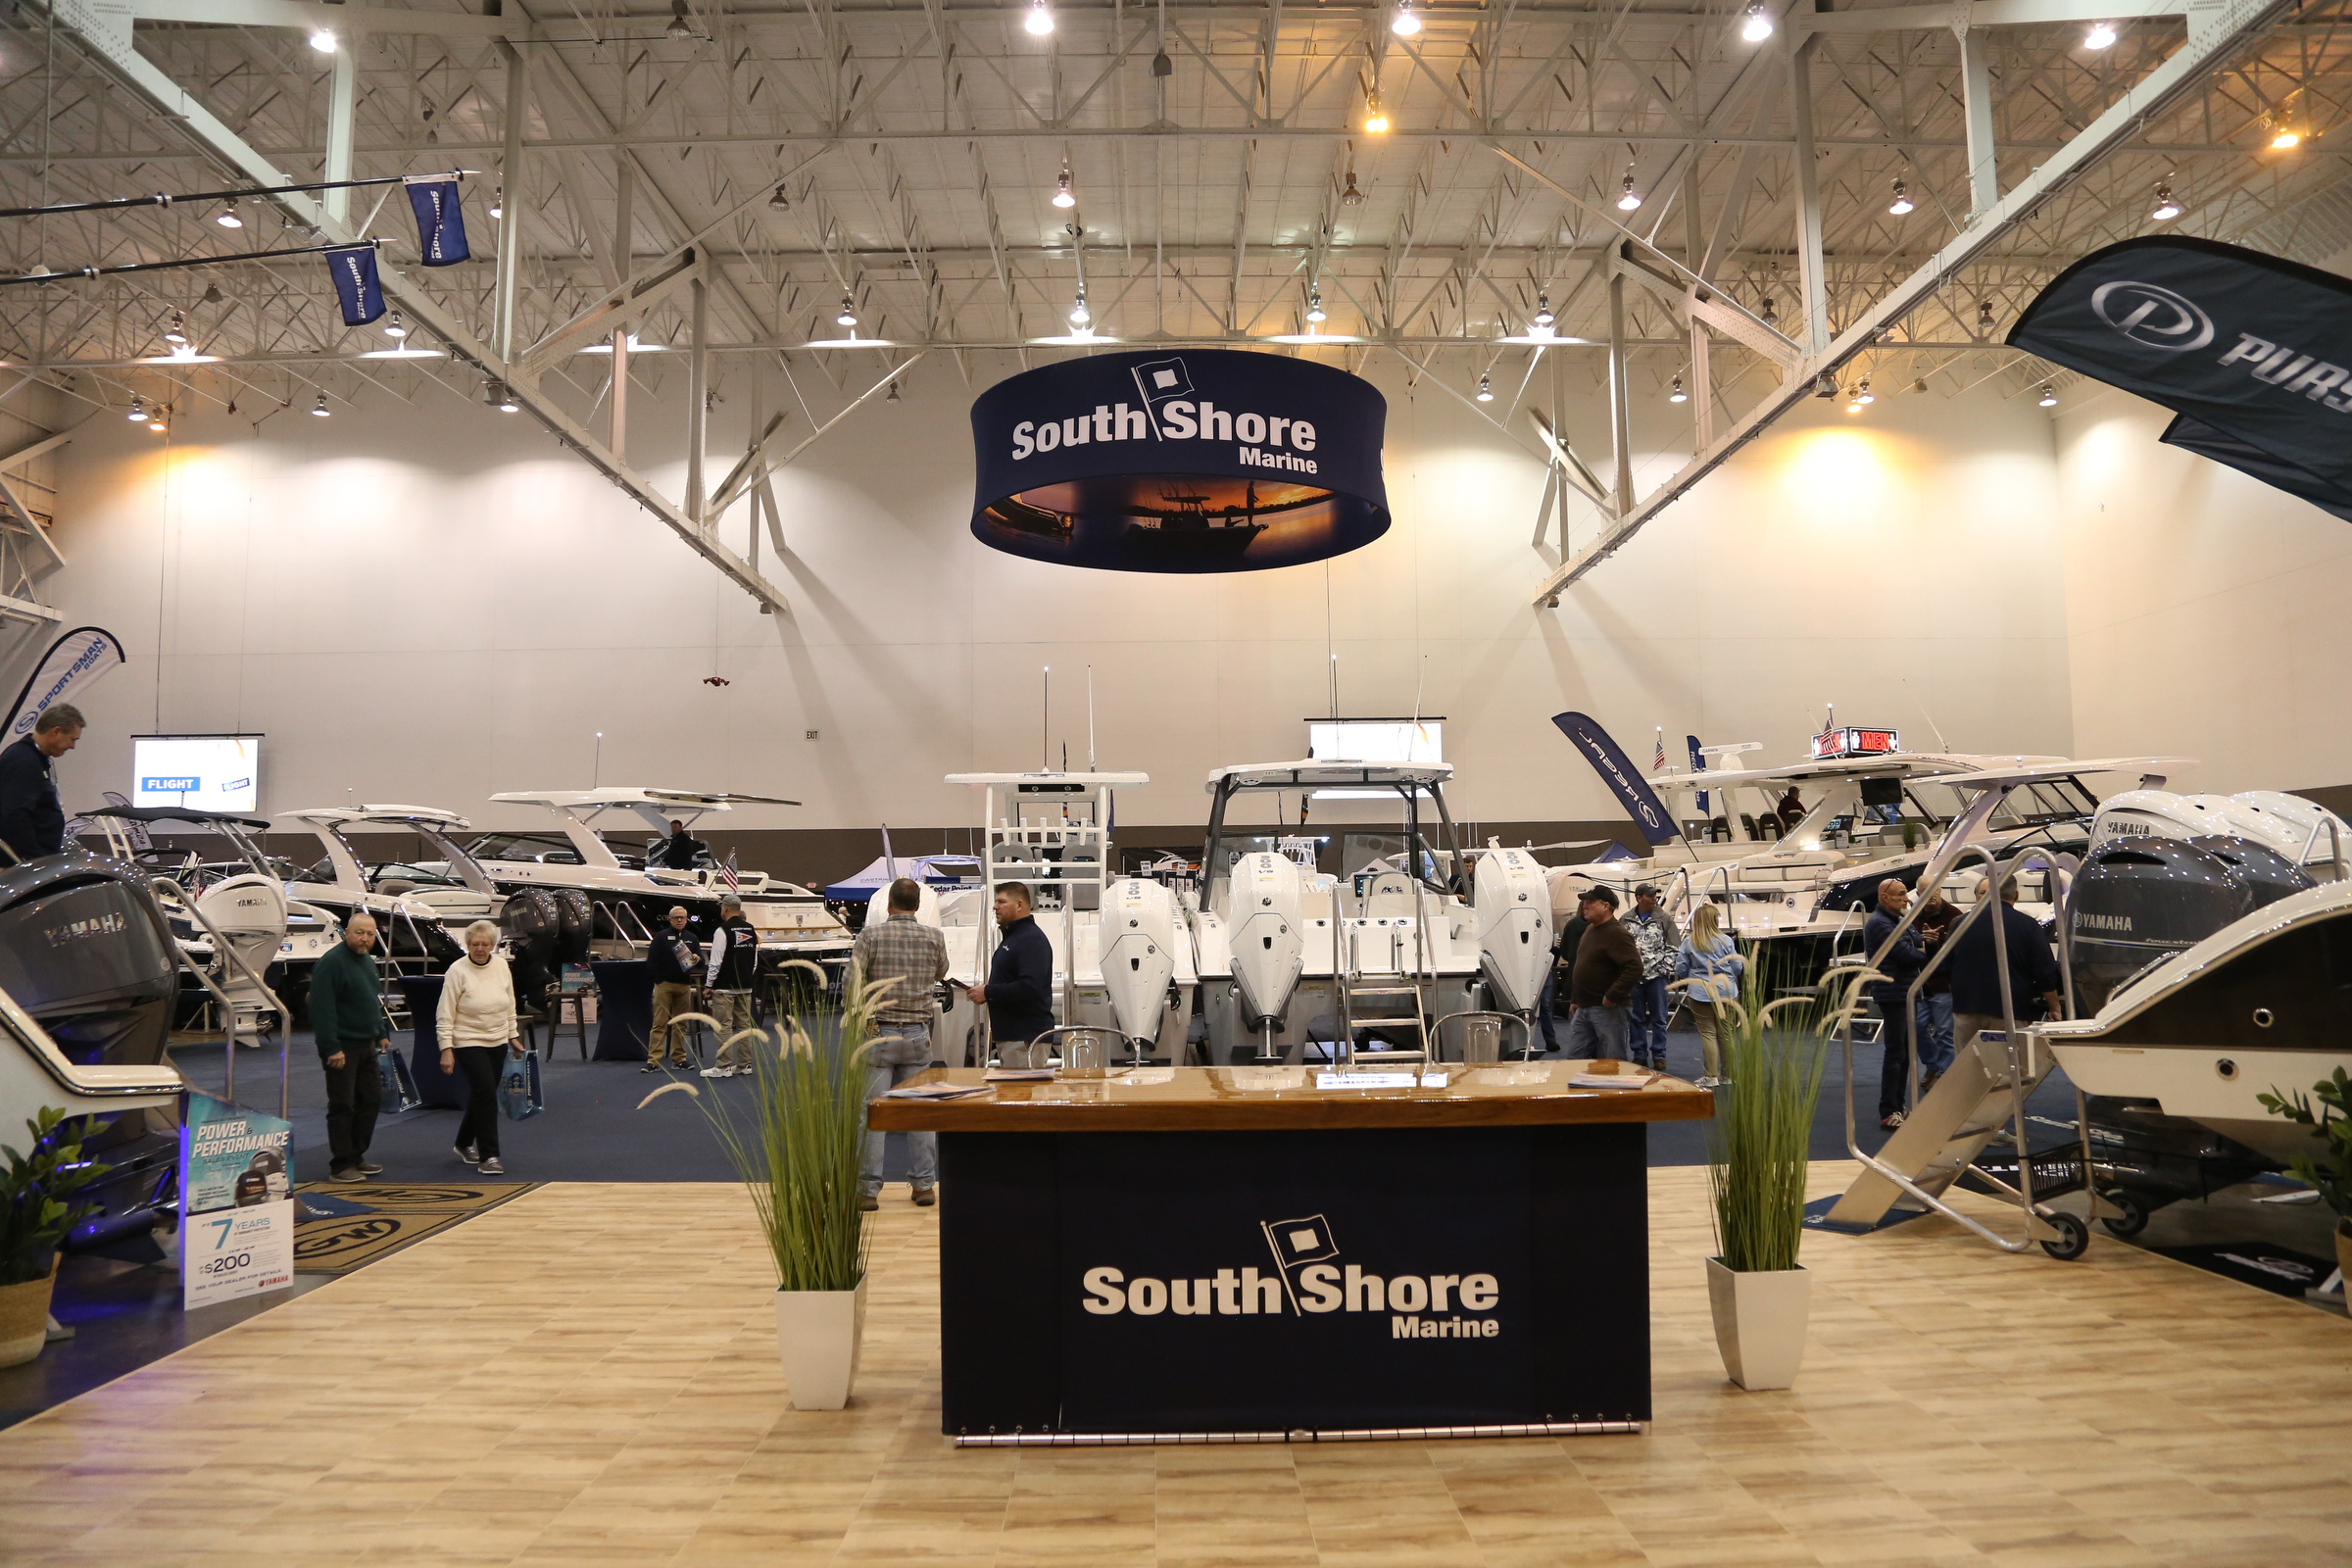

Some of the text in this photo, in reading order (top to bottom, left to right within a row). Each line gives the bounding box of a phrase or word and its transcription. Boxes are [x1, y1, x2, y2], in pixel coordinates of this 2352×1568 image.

[1011, 400, 1317, 461] South Shore
[1239, 446, 1318, 474] Marine
[83, 643, 108, 670] BOATS
[37, 636, 104, 711] SPORTSMAN
[1861, 732, 1889, 750] MEN
[147, 779, 194, 789] FLIGHT
[223, 779, 249, 790] FLIGHT
[2108, 821, 2150, 835] YAMAHA
[236, 899, 267, 907] YAMAHA
[43, 911, 128, 948] YAMAHA
[2083, 913, 2132, 931] YAMAHA
[196, 1121, 247, 1142] POWER
[192, 1130, 290, 1159] PERFORMANCE
[211, 1218, 233, 1250] 7
[235, 1217, 270, 1231] YEARS
[204, 1252, 251, 1274] $200
[265, 1275, 289, 1286] YAMAHA
[1082, 1264, 1499, 1315] South Shore
[1392, 1316, 1499, 1339] Marine
